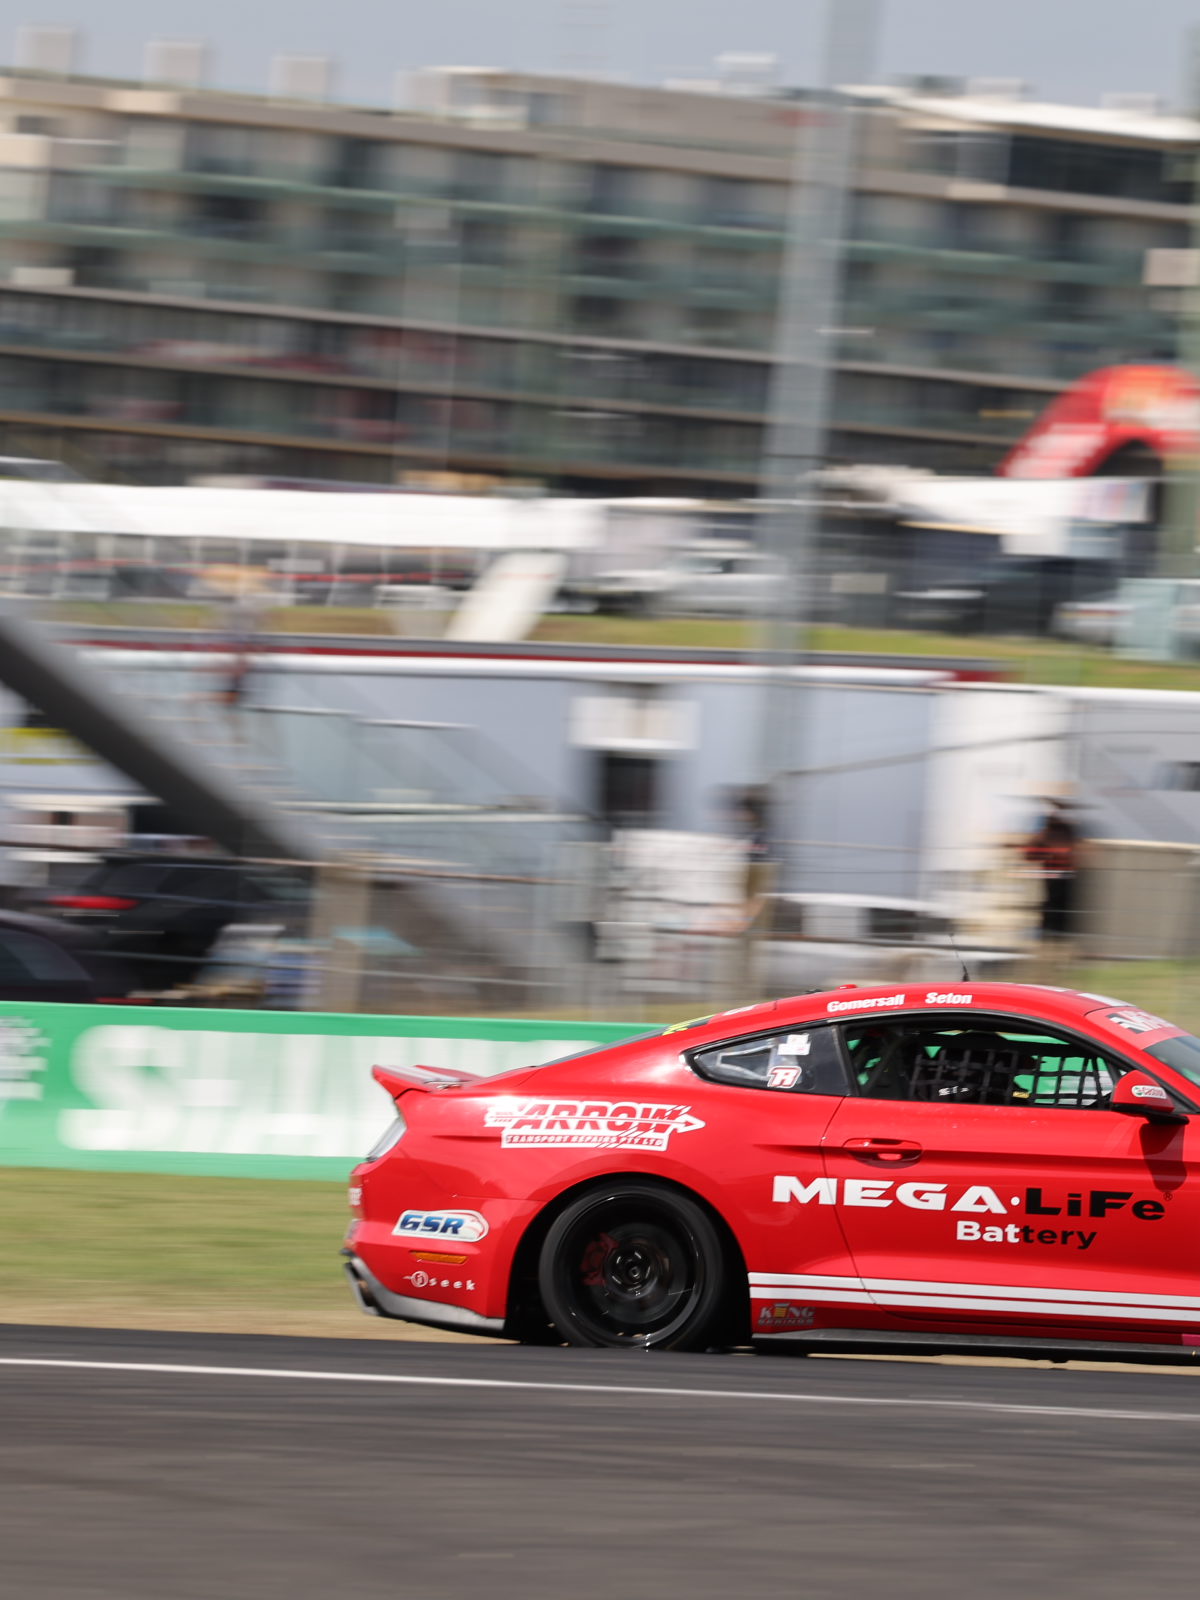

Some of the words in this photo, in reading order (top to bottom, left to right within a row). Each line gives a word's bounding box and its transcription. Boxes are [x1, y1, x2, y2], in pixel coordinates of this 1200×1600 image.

[827, 994, 905, 1012] Gomersall
[925, 992, 973, 1004] Seton
[511, 1102, 686, 1133] ARROW
[505, 1134, 569, 1144] TRANSPORT
[570, 1135, 618, 1145] REPAIRS
[618, 1136, 642, 1146] PTY
[642, 1137, 664, 1147] LTD
[400, 1214, 465, 1235] GSR
[956, 1221, 1098, 1249] Battery
